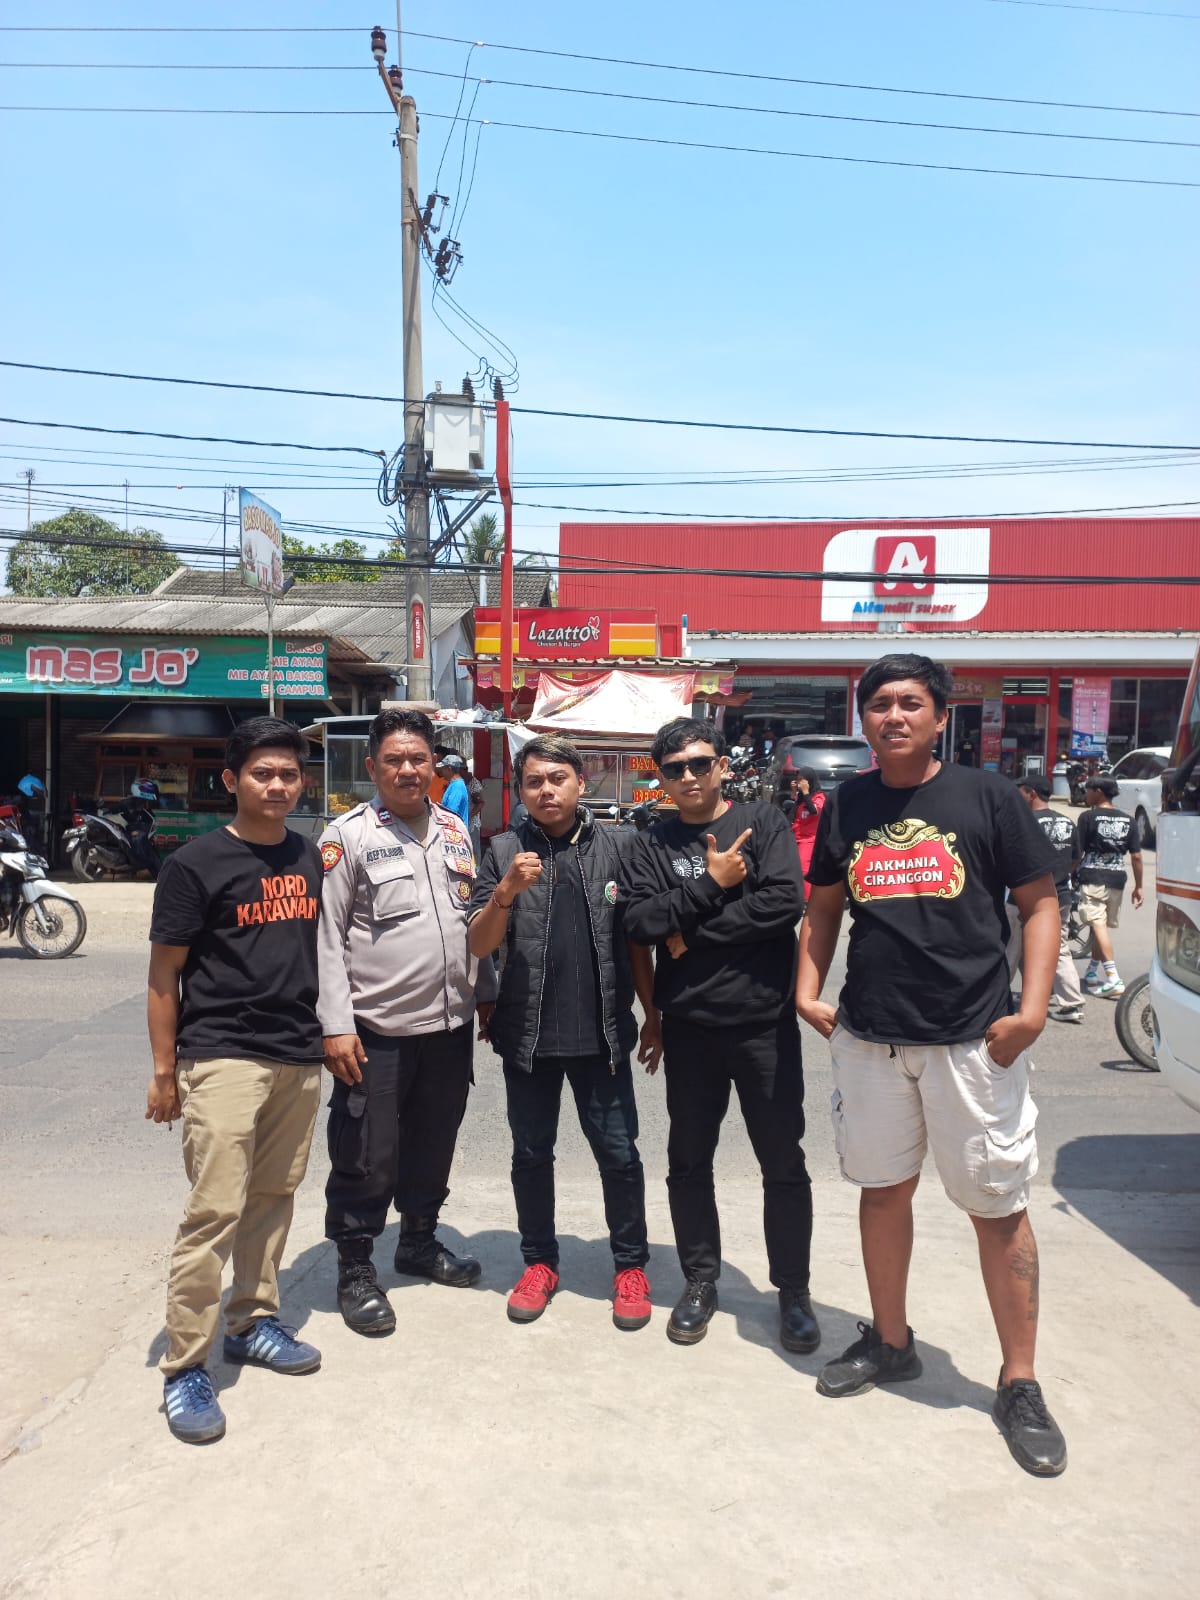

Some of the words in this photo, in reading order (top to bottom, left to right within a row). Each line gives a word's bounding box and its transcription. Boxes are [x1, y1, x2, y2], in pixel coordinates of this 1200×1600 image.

[915, 604, 957, 615] super
[529, 620, 591, 642] Lazatto
[290, 657, 323, 668] AYAM
[228, 669, 248, 680] MIE
[286, 671, 323, 681] BAKSO
[277, 685, 325, 695] CAMPUR
[444, 845, 470, 858] POLRI
[866, 856, 939, 872] JAKMANIA
[863, 870, 943, 886] CIRANGGON
[261, 874, 307, 900] NORD
